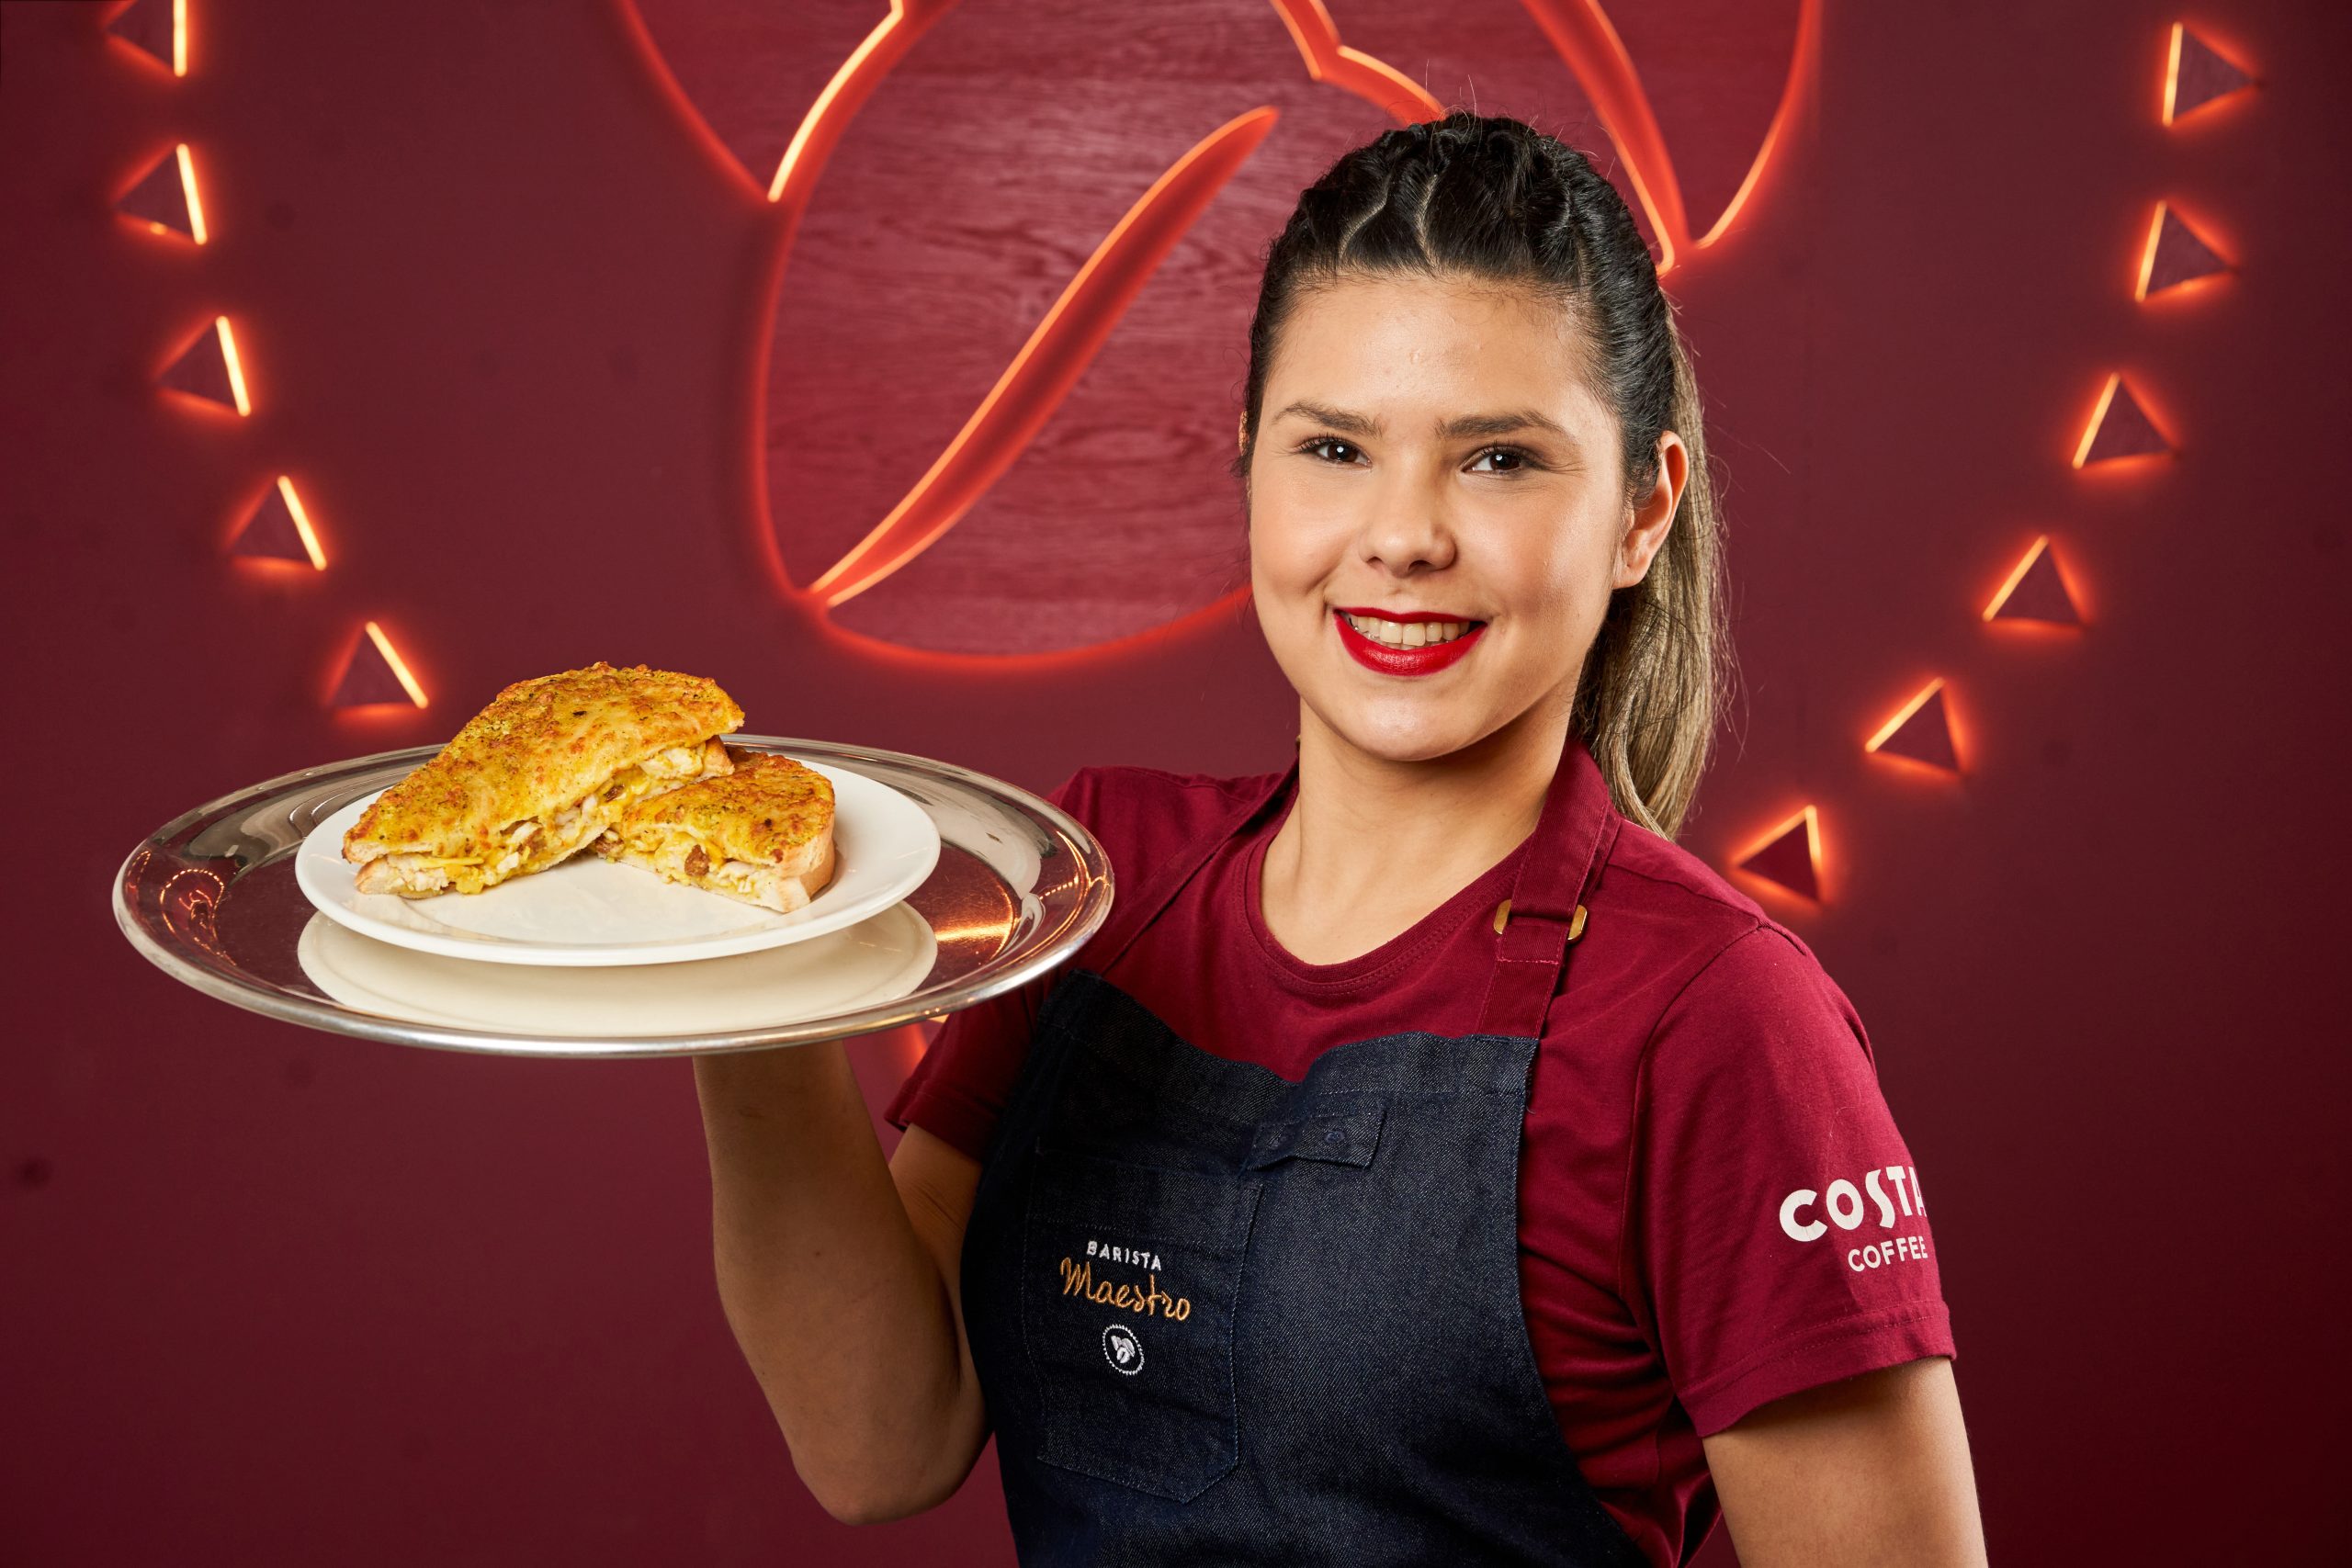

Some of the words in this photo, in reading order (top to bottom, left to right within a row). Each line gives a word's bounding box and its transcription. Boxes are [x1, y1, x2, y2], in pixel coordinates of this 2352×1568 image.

[1779, 1165, 1928, 1242] COSTA
[1086, 1241, 1161, 1270] BARISTA
[1848, 1235, 1928, 1272] COFFEE
[1059, 1257, 1191, 1321] Maestro
